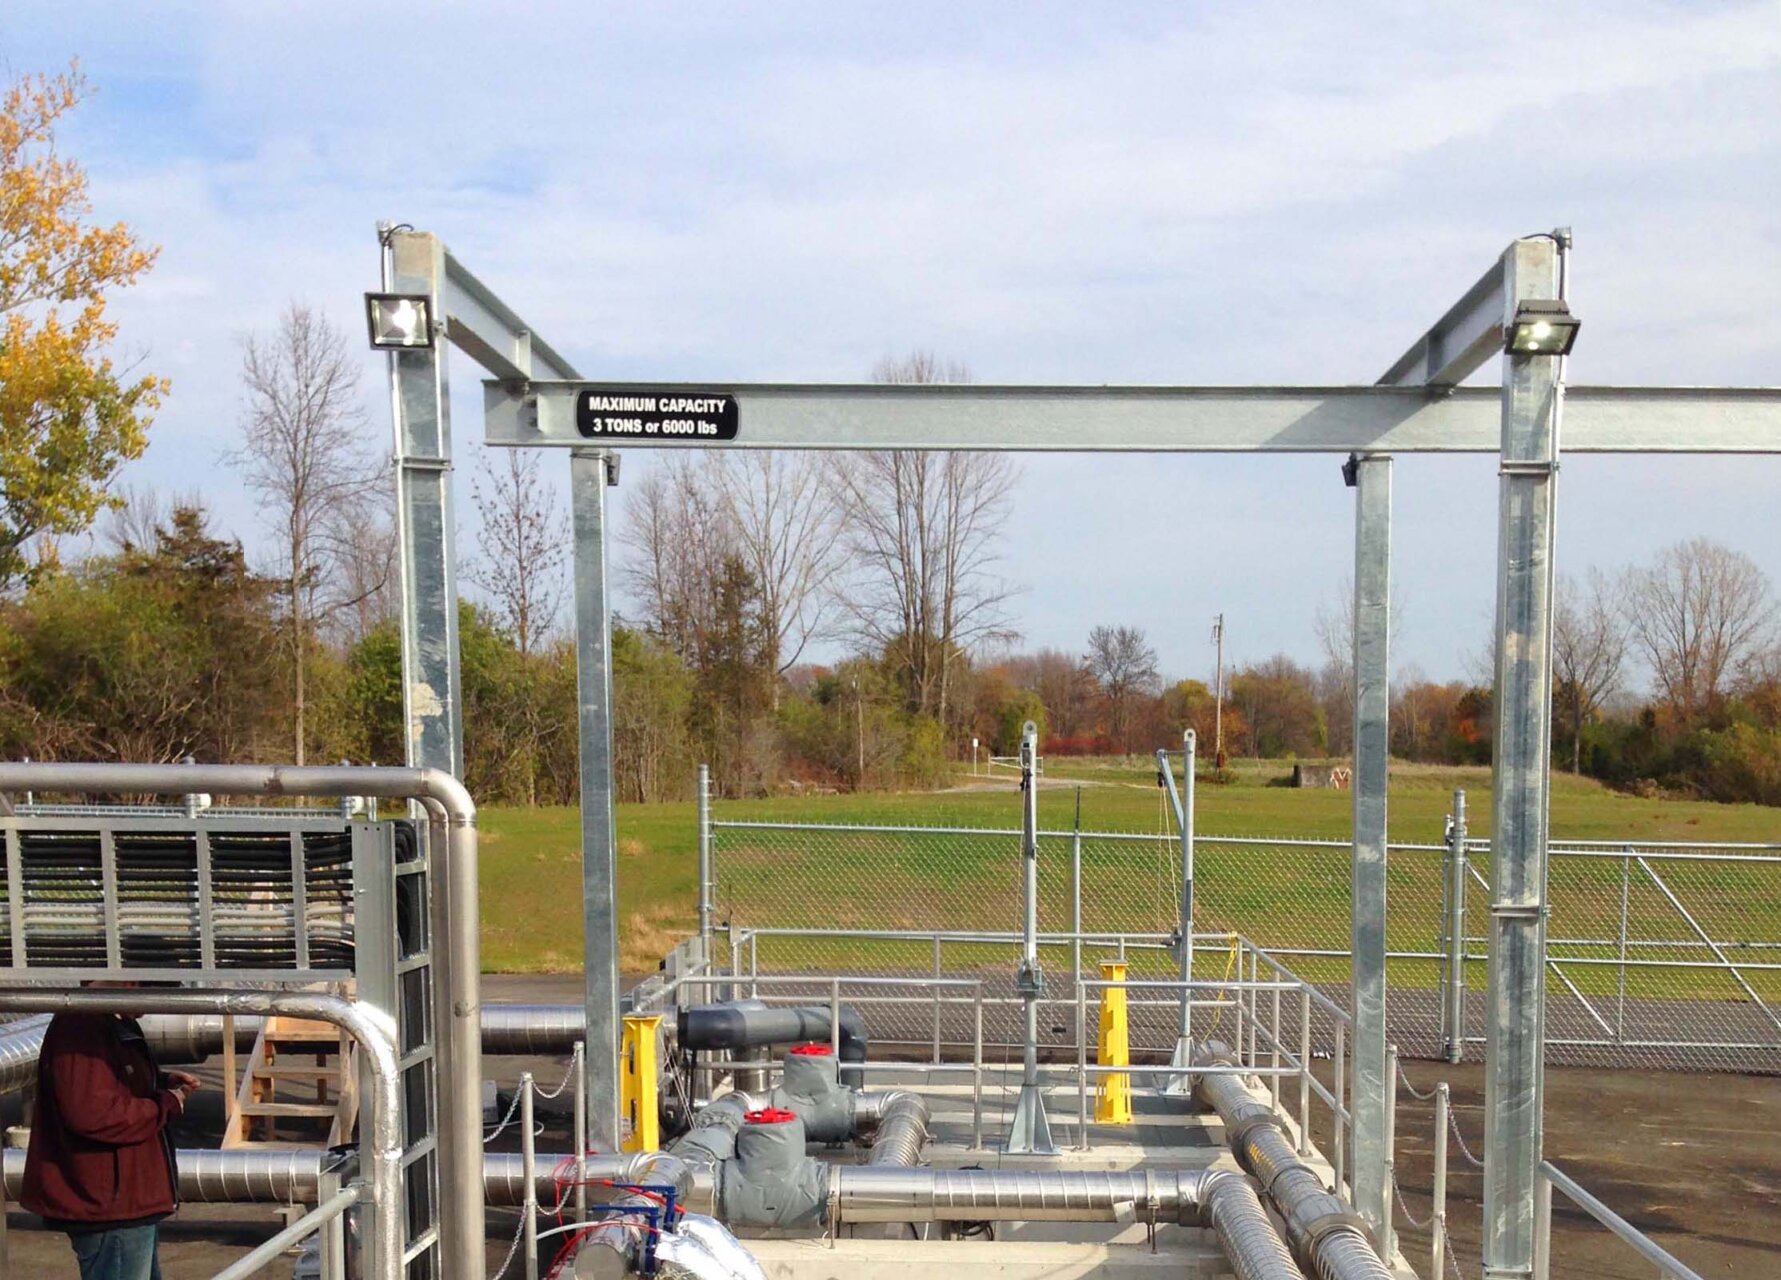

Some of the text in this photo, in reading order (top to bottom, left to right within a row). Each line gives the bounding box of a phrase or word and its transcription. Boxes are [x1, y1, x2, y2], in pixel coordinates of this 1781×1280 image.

[589, 397, 726, 413] MAXIMUM CAPACITY
[593, 418, 718, 434] 3 TONS or 6000 lbs
